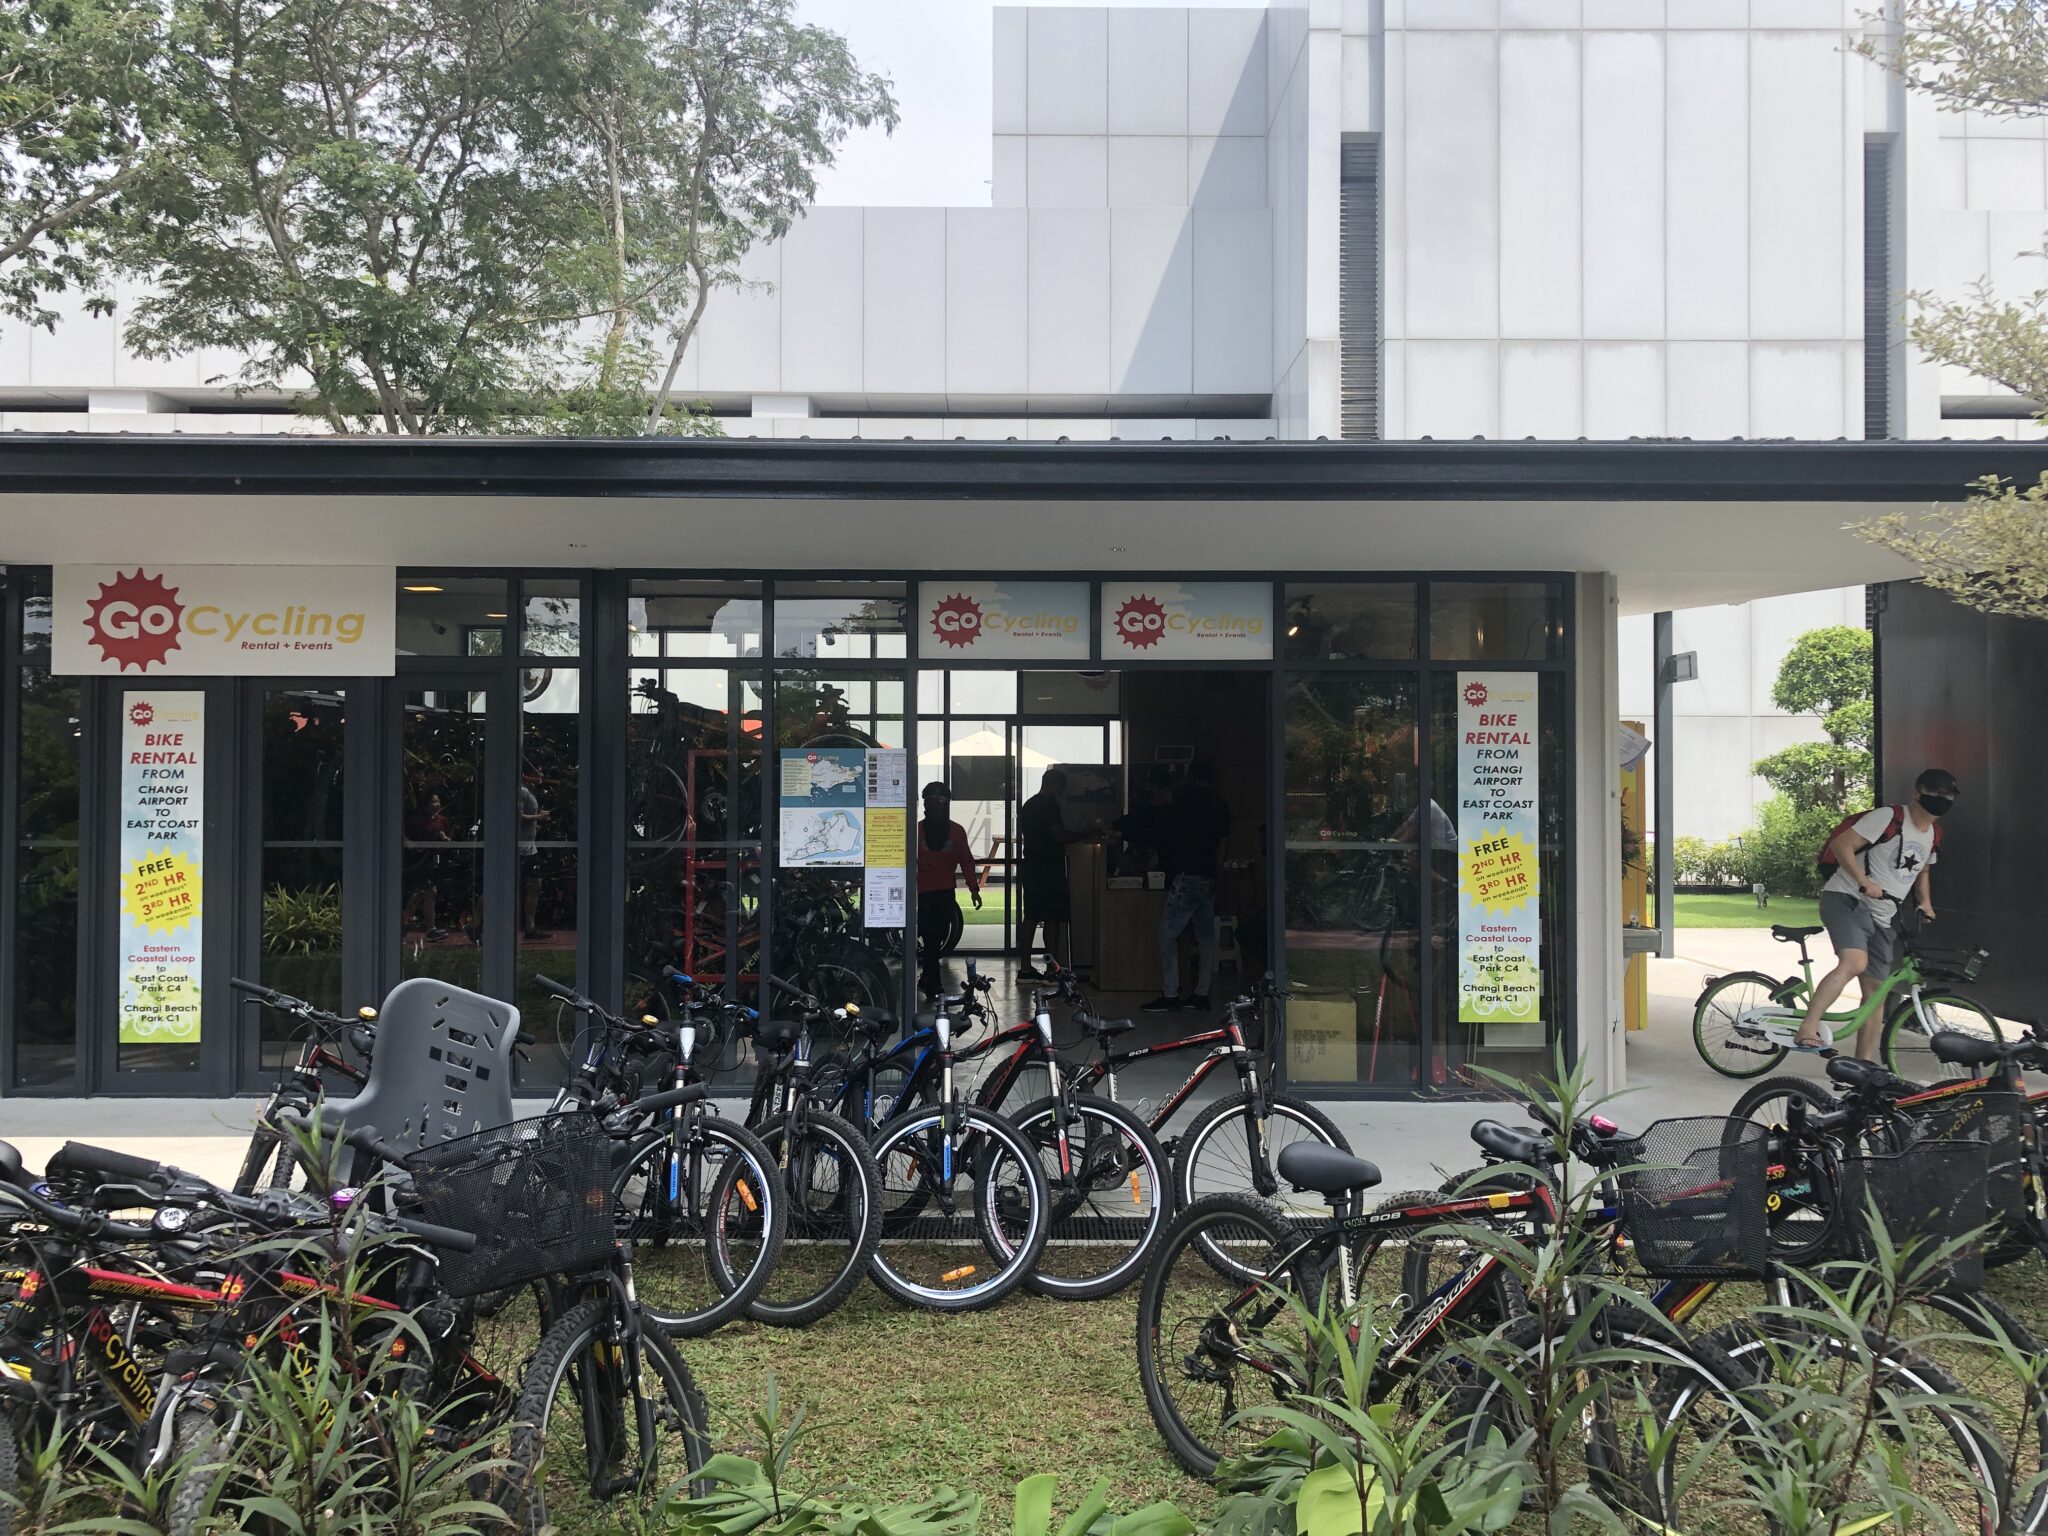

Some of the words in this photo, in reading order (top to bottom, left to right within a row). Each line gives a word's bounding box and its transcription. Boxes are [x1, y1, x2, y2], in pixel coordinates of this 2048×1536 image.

[186, 606, 366, 643] Cycling
[984, 612, 1079, 633] Cycling
[1168, 612, 1264, 634] Cycling
[241, 641, 280, 650] Rental
[294, 641, 333, 650] Events
[1479, 714, 1518, 726] BIKE
[145, 733, 183, 746] BIKE
[1465, 732, 1531, 745] RENTAL
[130, 752, 197, 764] RENTAL
[1476, 749, 1519, 759] FROM
[142, 769, 184, 779] FROM
[1473, 765, 1522, 774] CHANGI
[1473, 777, 1523, 786] AIRPORT
[138, 785, 188, 794] CHANGI
[1490, 789, 1506, 797] TO
[138, 797, 188, 806] AIRPORT
[1463, 800, 1490, 808] EAST
[1493, 800, 1534, 808] COAST
[155, 808, 170, 817] TO
[1482, 811, 1514, 820] PARK
[127, 820, 155, 828] EAST
[158, 820, 199, 828] COAST
[147, 831, 178, 840] PARK
[1474, 837, 1510, 857] FREE
[1500, 851, 1522, 866] HR
[138, 857, 174, 877] FREE
[163, 871, 186, 886] HR
[1505, 872, 1527, 888] HR
[168, 892, 191, 907] HR
[1507, 935, 1532, 943] Loop
[143, 945, 180, 953] Eastern
[170, 955, 195, 963] Loop
[1463, 984, 1500, 993] Changi
[1503, 984, 1535, 992] Beach
[1479, 994, 1502, 1002] Park
[1504, 994, 1518, 1002] C1
[124, 1005, 162, 1013] Changi
[166, 1014, 180, 1022] C1
[1370, 1211, 1401, 1222] 808
[1345, 1247, 1358, 1301] ASCENT
